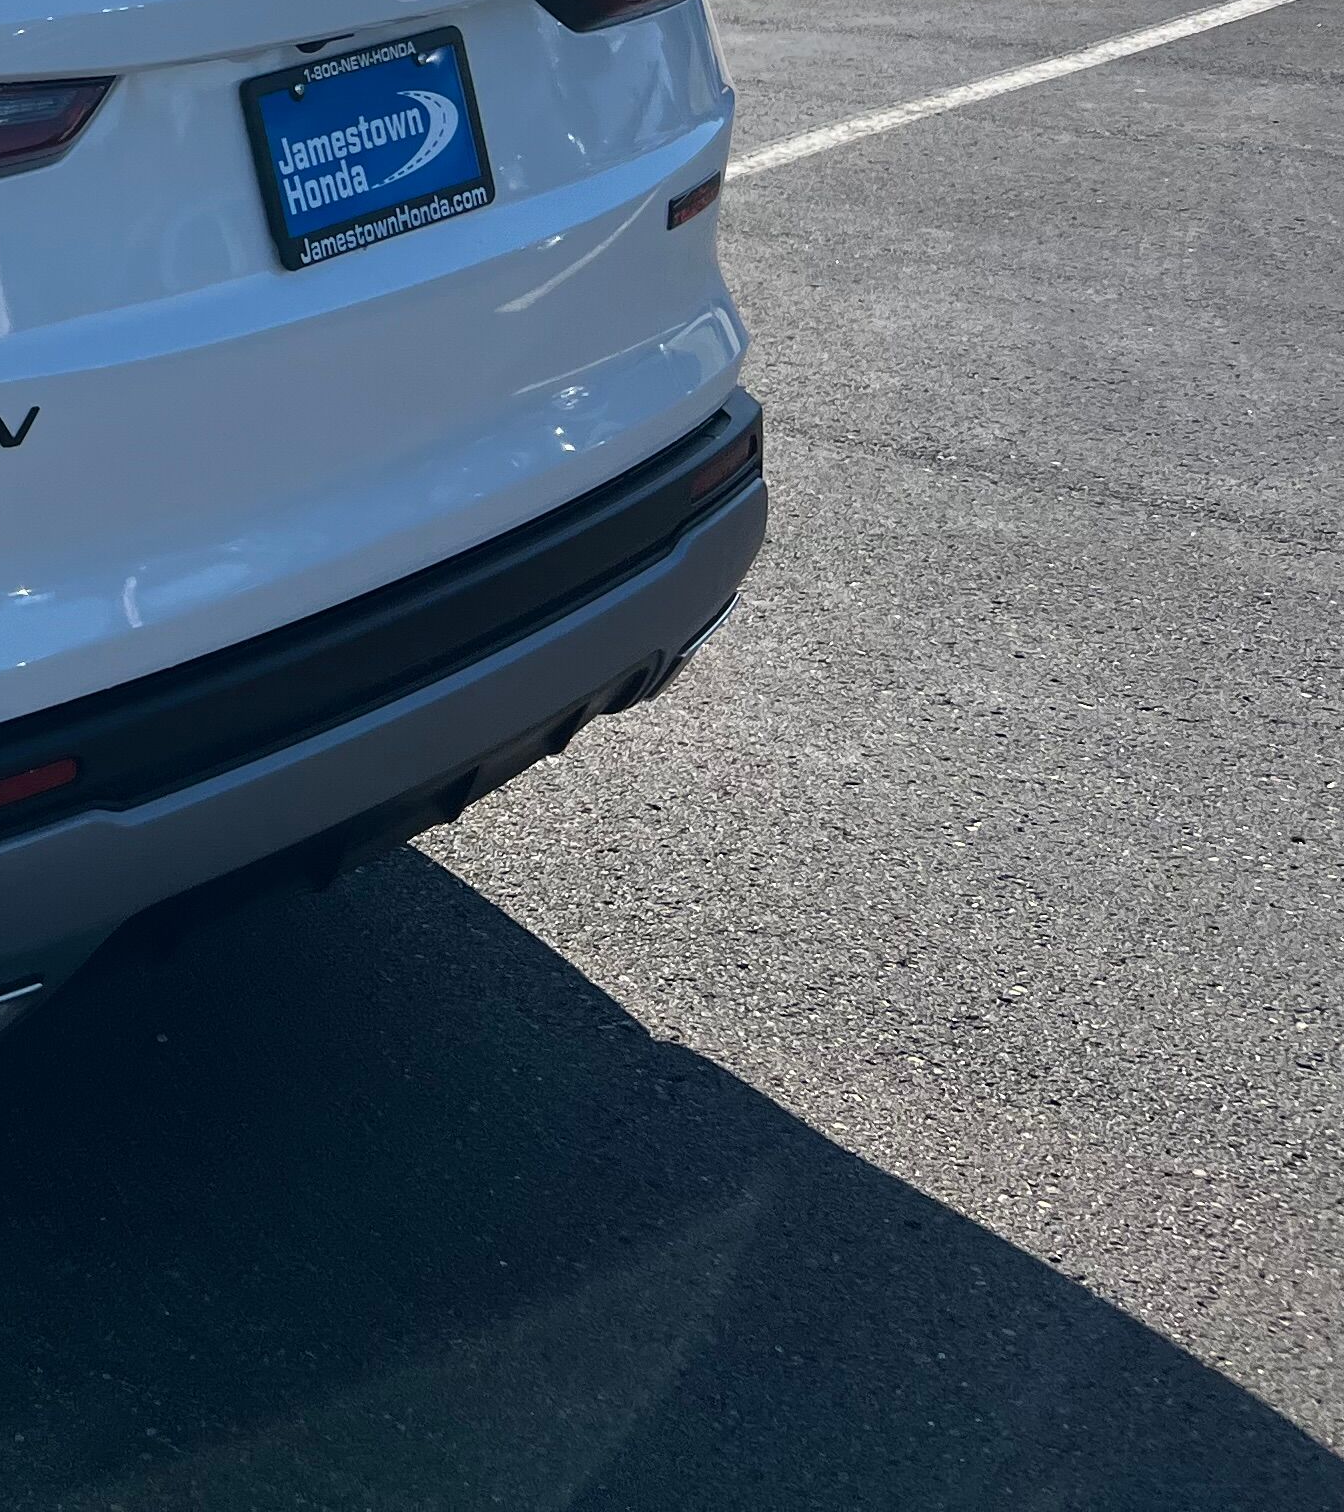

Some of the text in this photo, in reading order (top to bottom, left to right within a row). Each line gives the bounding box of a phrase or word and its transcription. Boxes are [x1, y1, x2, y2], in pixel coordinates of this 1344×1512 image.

[303, 41, 417, 83] 1-800-NEW-HONDA
[278, 106, 425, 175] Jamestown
[283, 159, 370, 215] Honda
[300, 186, 488, 265] JamestownHonda.com
